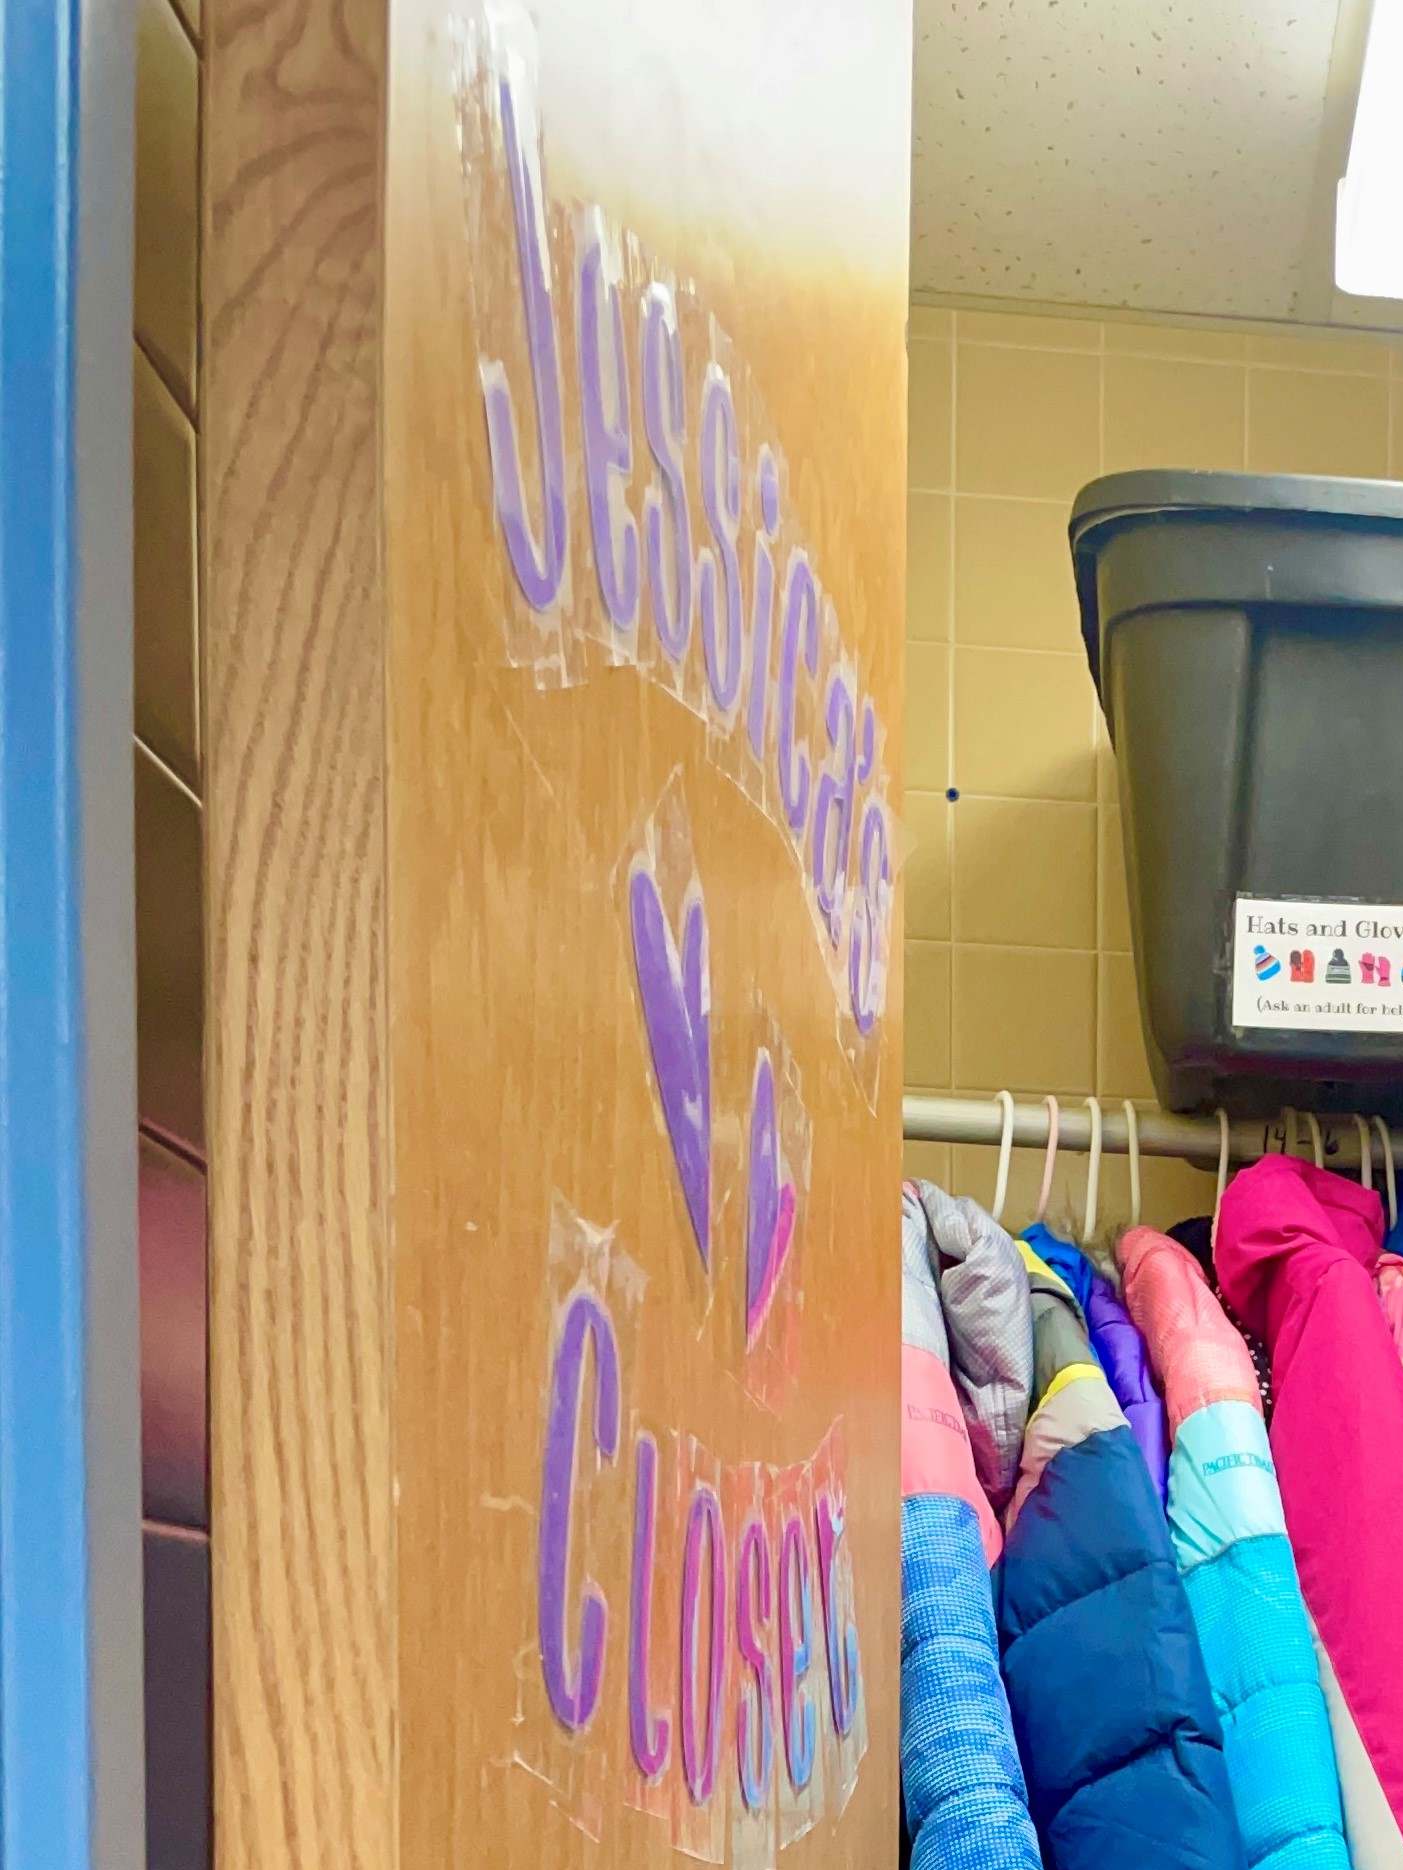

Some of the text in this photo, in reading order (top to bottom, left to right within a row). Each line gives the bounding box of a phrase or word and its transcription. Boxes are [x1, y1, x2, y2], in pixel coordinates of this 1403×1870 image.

[1246, 915, 1299, 936] Hats
[1306, 920, 1348, 937] and
[1256, 996, 1290, 1013] (Ask
[1294, 1003, 1311, 1012] an
[1315, 1002, 1351, 1014] adult
[1356, 1003, 1378, 1015] for
[538, 1292, 862, 1810] Closet
